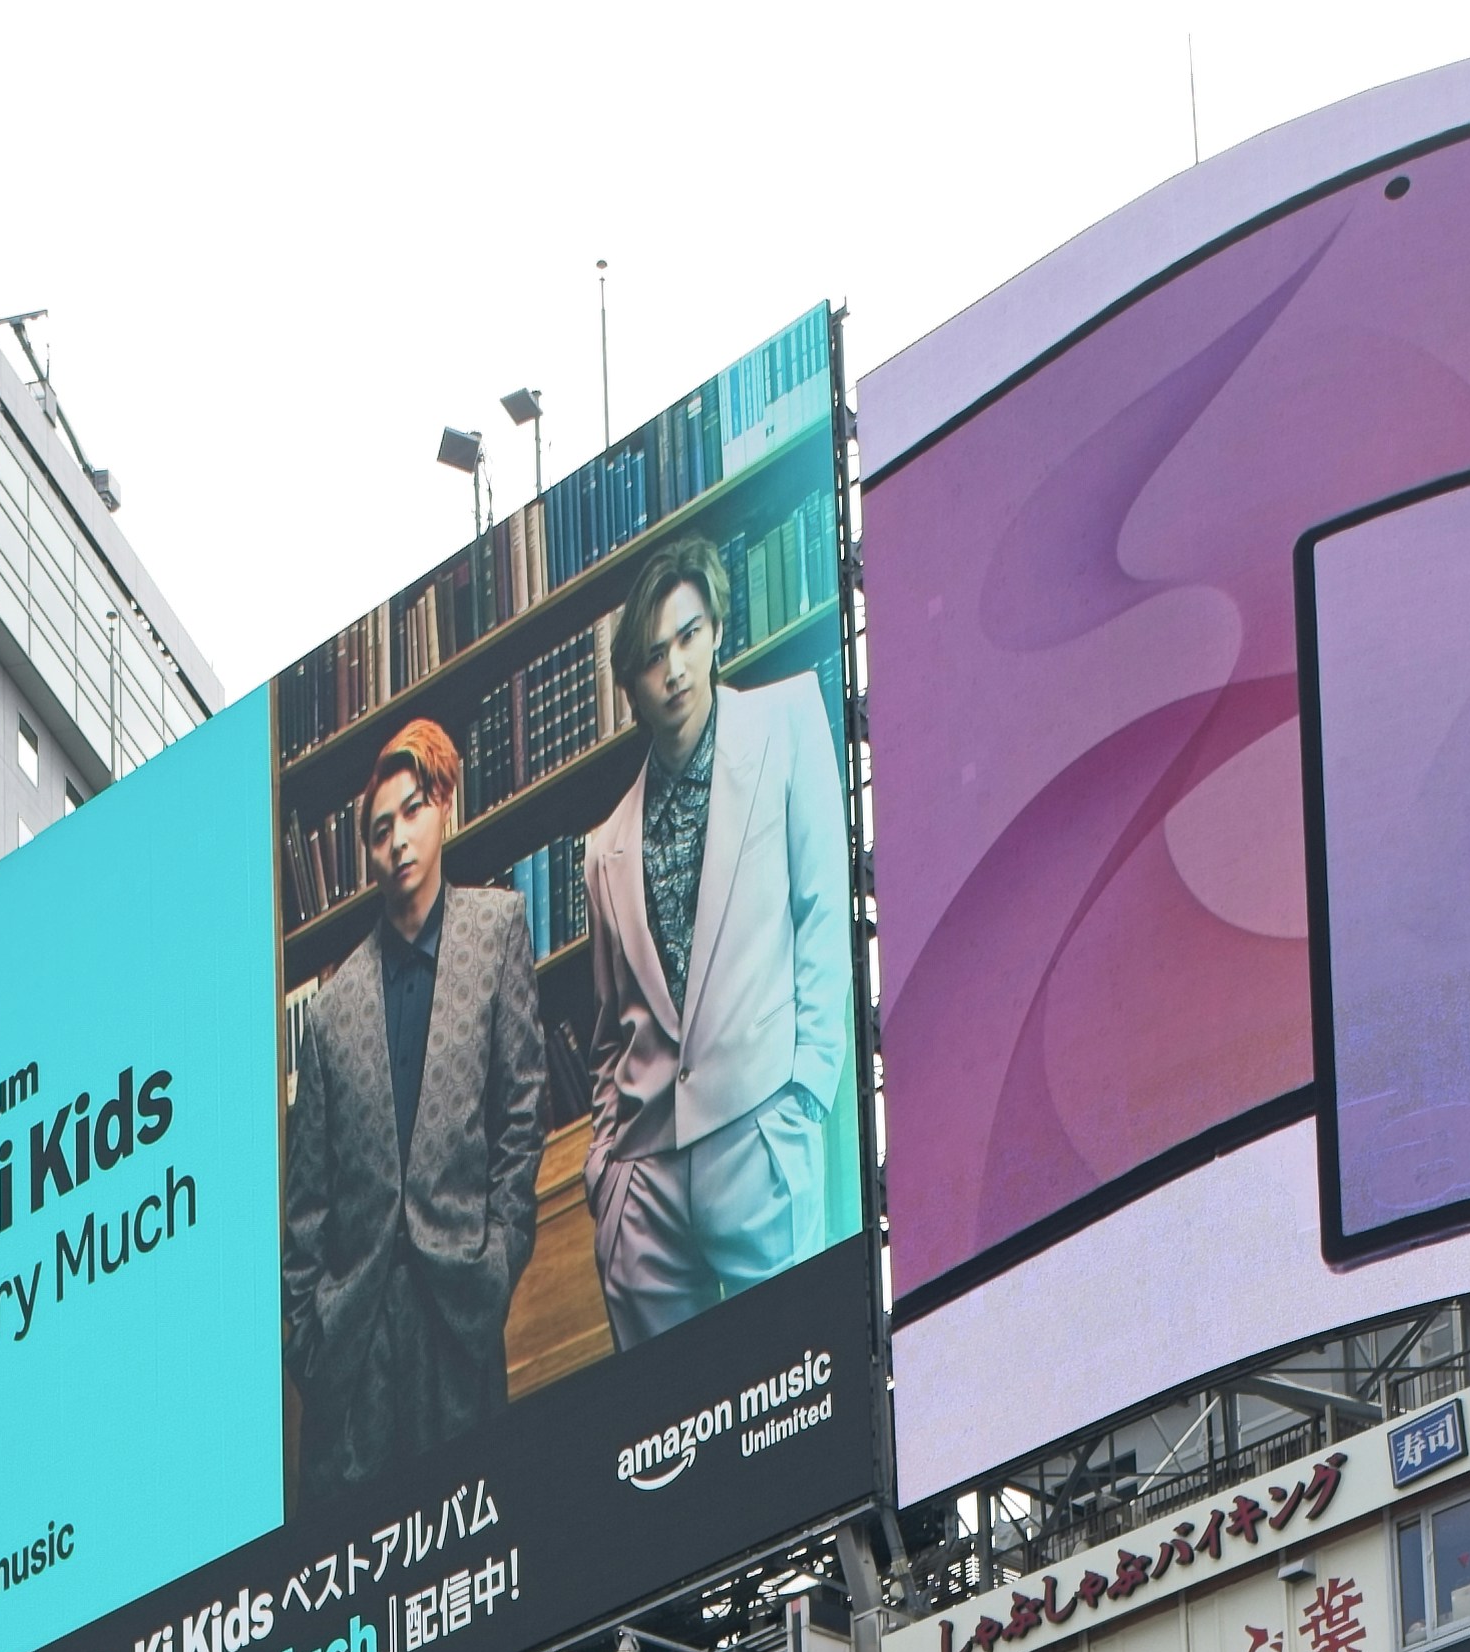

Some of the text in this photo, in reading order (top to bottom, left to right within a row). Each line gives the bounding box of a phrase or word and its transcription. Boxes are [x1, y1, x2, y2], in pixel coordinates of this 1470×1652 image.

[30, 1069, 175, 1192] Kids
[56, 1169, 198, 1302] Much
[616, 1350, 833, 1492] amazon music
[740, 1396, 833, 1459] Unlimited
[1395, 1411, 1459, 1482] 寿司
[280, 1479, 501, 1610] ベストアルバム
